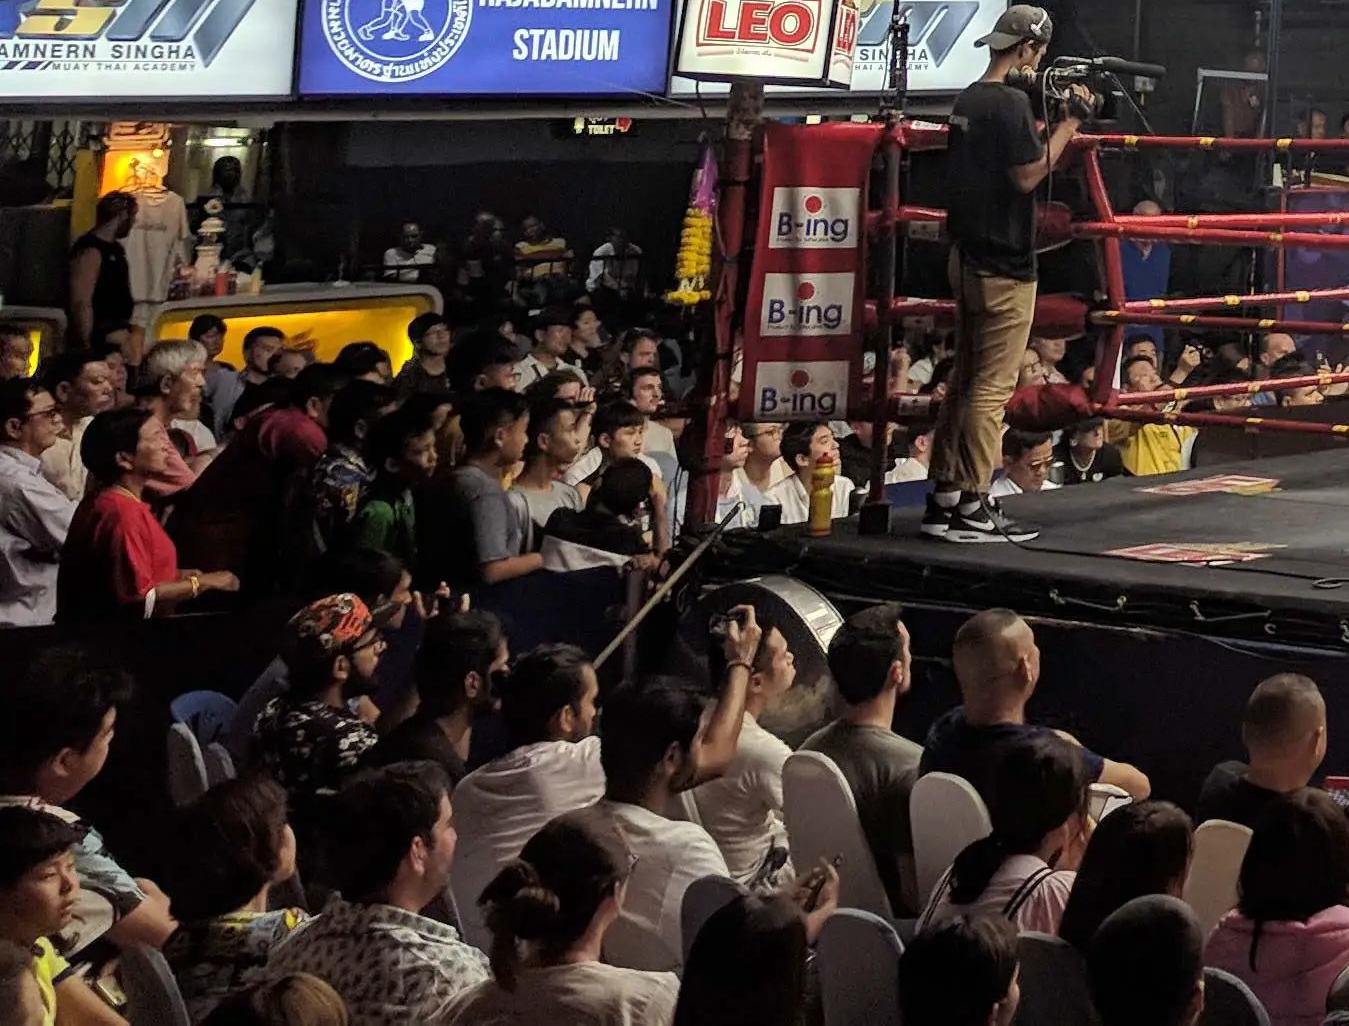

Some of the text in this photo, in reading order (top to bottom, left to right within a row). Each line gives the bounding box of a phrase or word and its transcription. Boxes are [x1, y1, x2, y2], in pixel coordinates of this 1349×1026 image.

[110, 43, 196, 60] SINGHA
[512, 27, 621, 61] STADIUM
[859, 48, 929, 61] SINHA
[51, 62, 196, 72] MUAY THAI ACADEMY
[776, 211, 849, 243] B-ing
[767, 298, 843, 330] B-ing
[759, 387, 837, 415] B-ing
